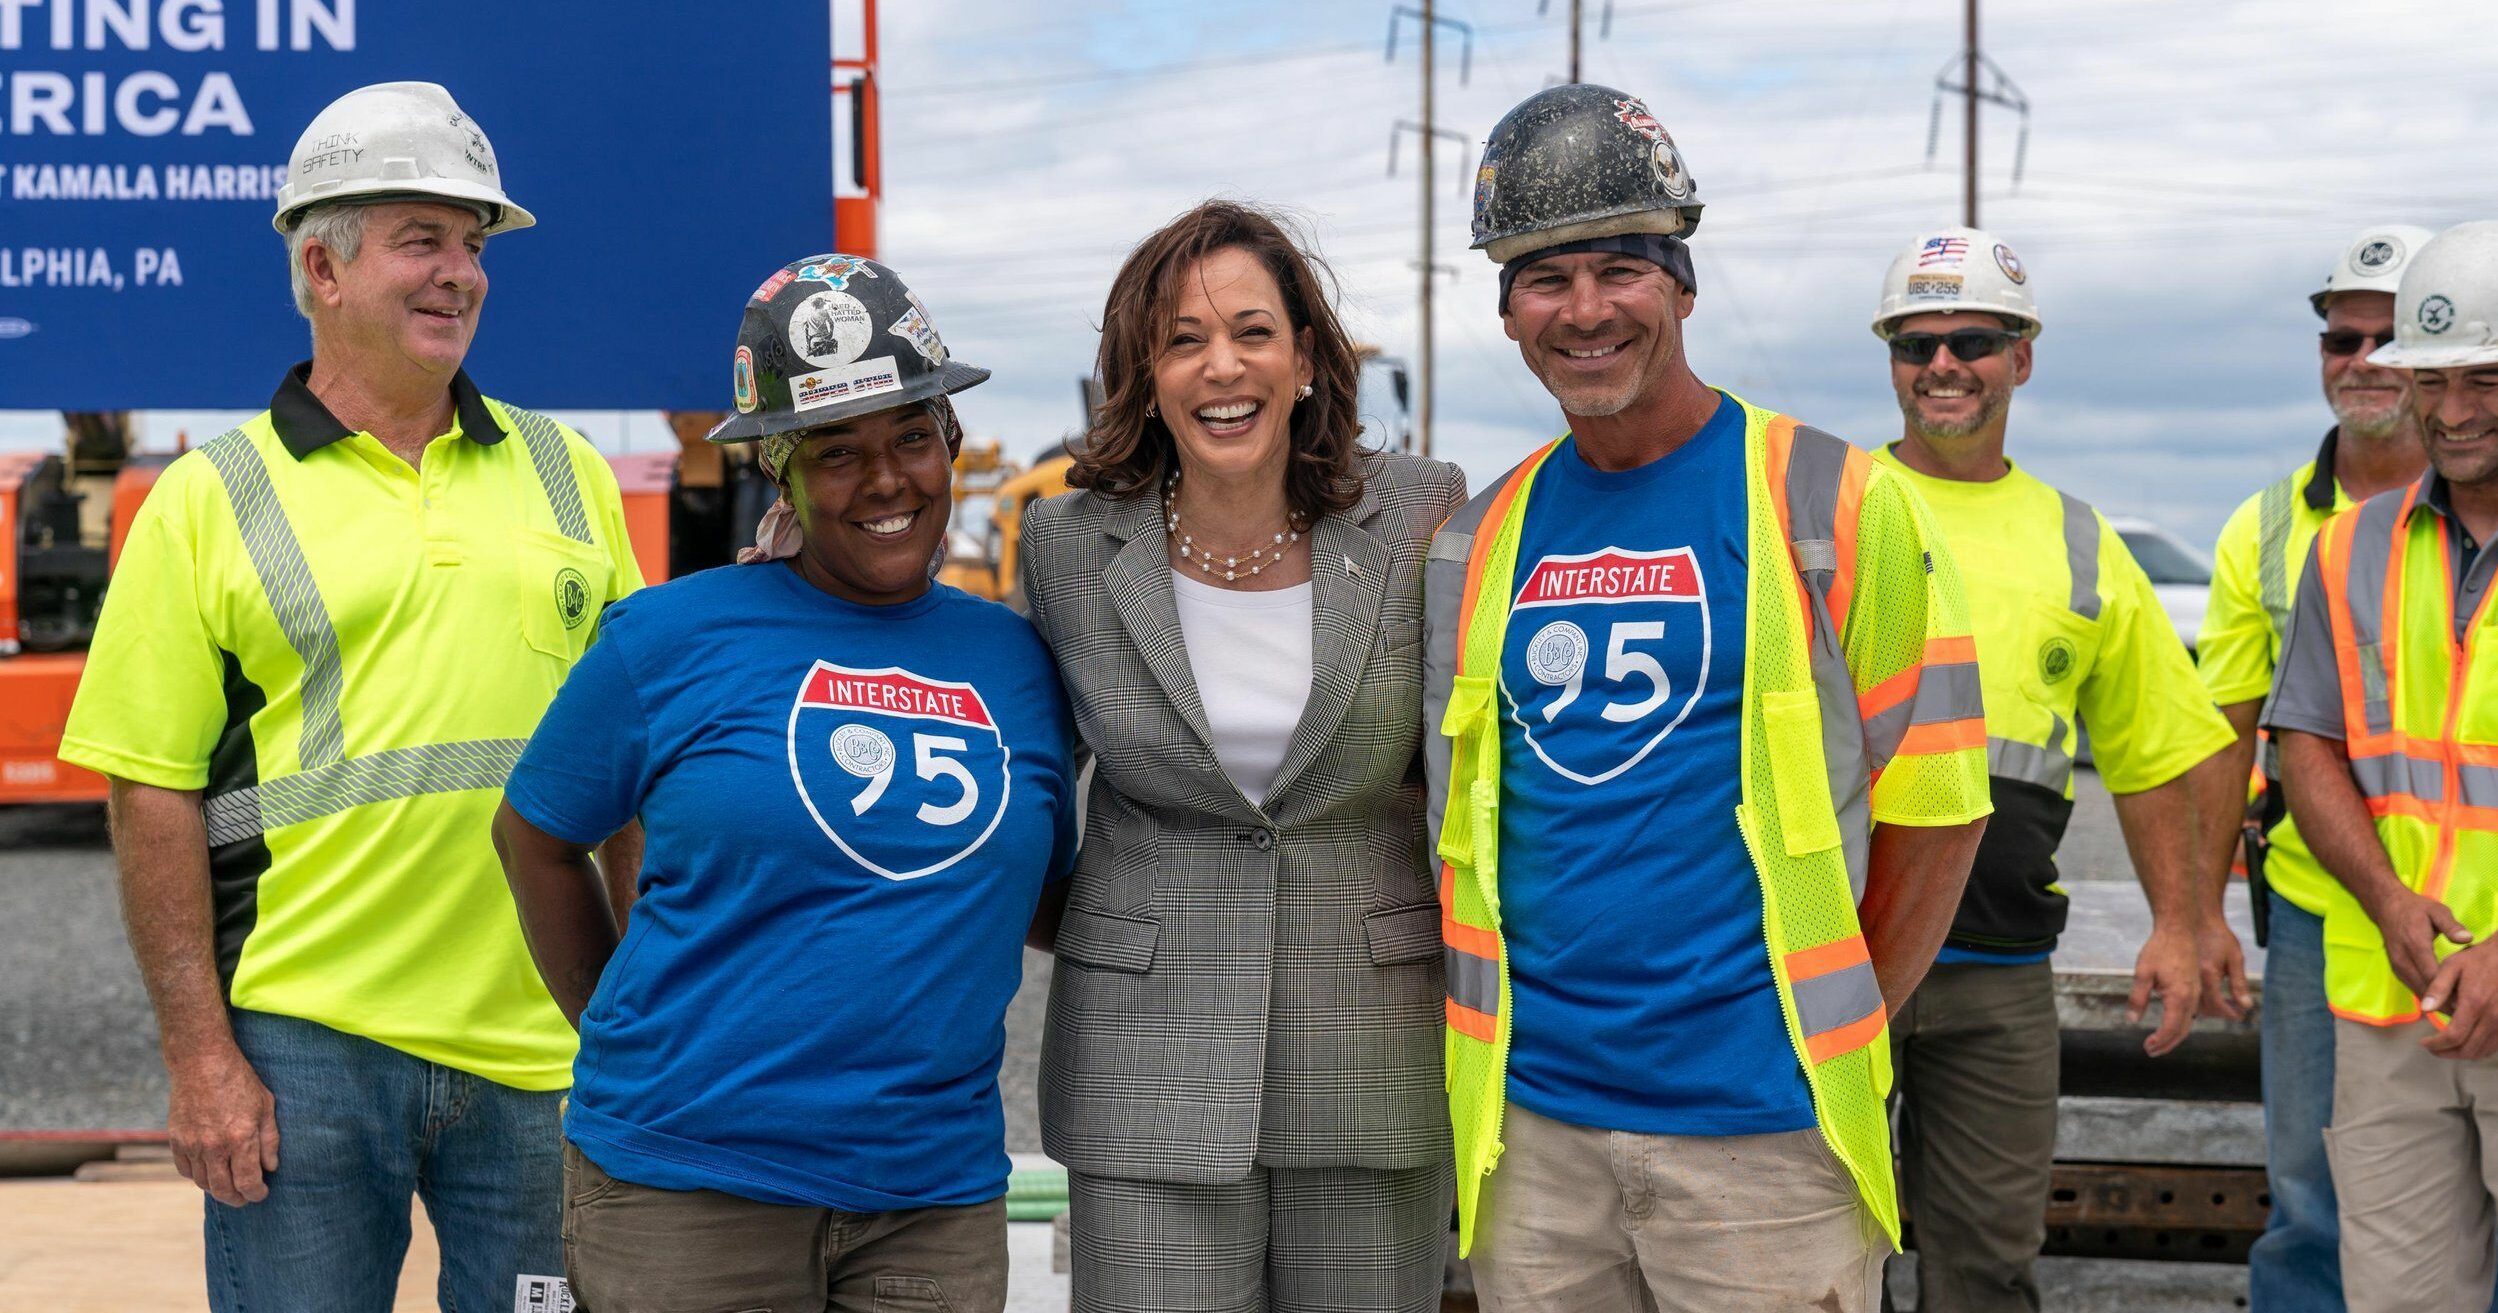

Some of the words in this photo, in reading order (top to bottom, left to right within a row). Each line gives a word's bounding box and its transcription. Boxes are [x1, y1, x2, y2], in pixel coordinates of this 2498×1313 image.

[0, 0, 225, 51] TING
[256, 0, 356, 51] IN
[0, 71, 255, 136] RICA
[303, 148, 365, 174] SAFETY
[312, 133, 360, 152] THINK
[13, 164, 158, 199] KAMALA
[0, 248, 124, 292] LPHIA,
[135, 248, 183, 286] PA
[1539, 565, 1675, 597] INTERSTATE
[1527, 621, 1671, 723] 95
[1534, 664, 1577, 681] CONTRACTORS
[828, 679, 966, 718] INTERSTATE
[830, 723, 979, 826] 95
